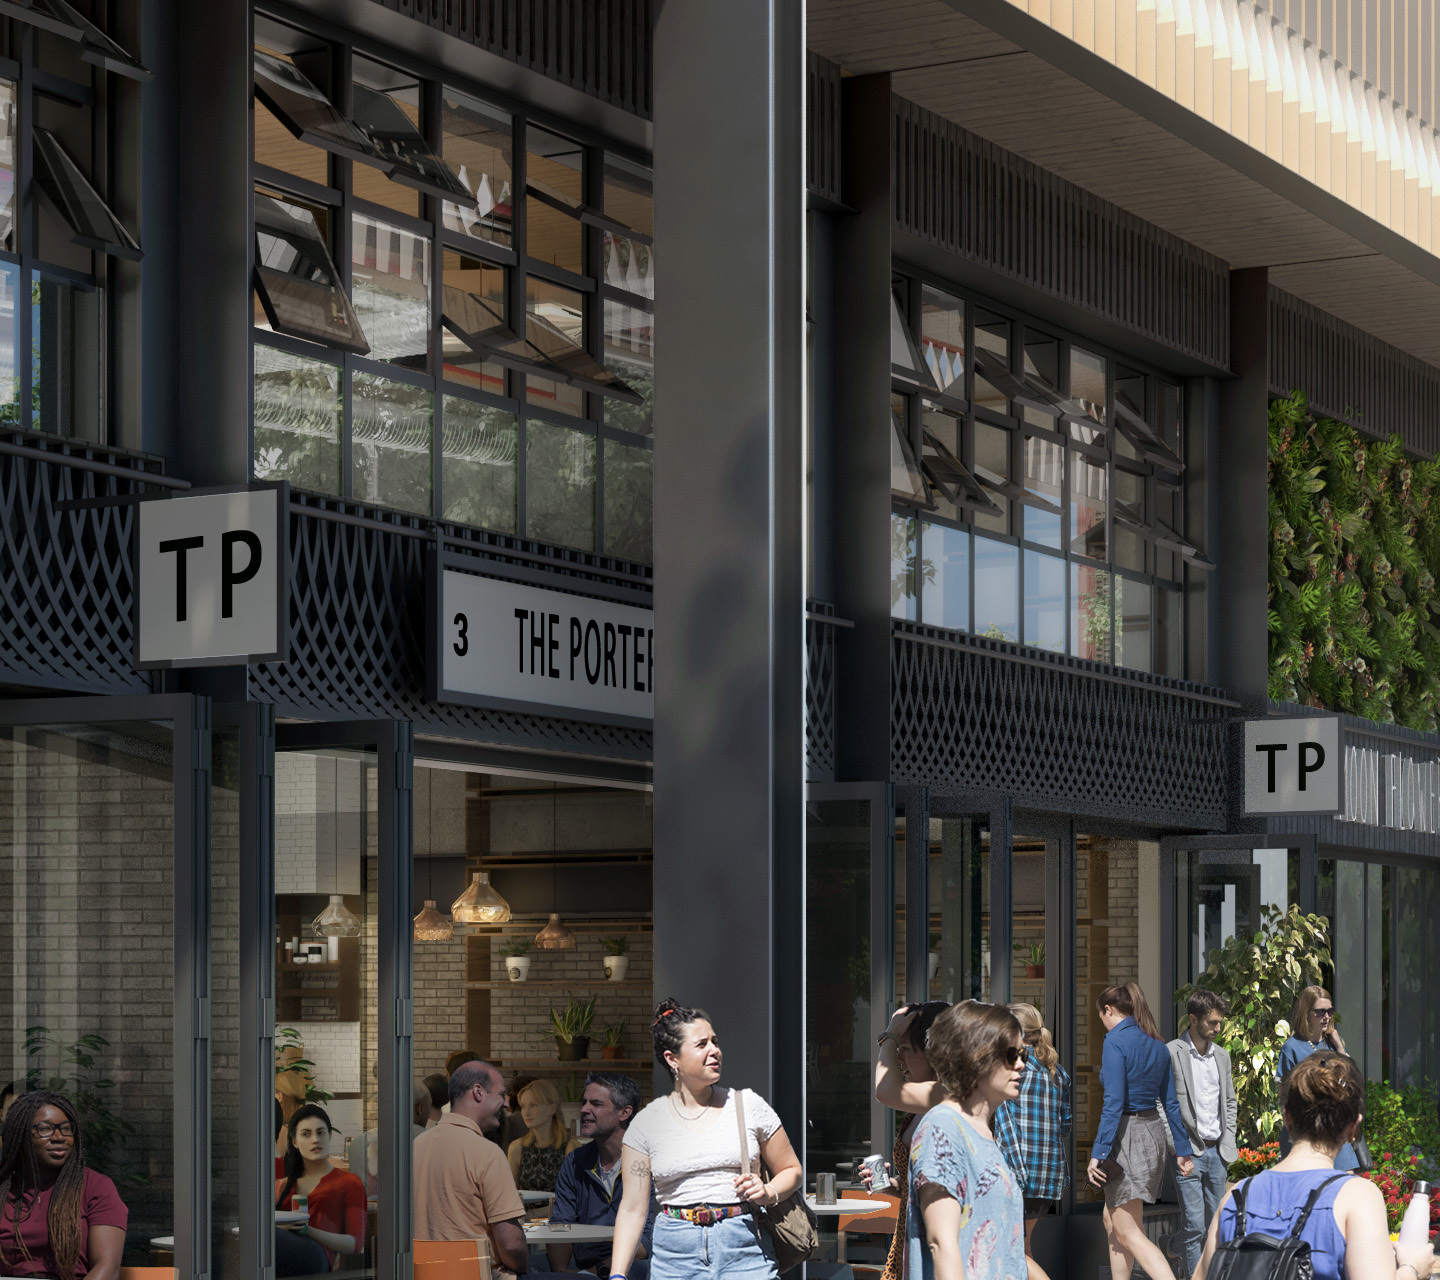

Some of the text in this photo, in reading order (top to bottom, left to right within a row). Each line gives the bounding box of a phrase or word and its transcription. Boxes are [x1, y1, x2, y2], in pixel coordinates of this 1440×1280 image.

[159, 529, 262, 622] TP
[453, 613, 469, 657] 3
[514, 608, 560, 679] THE
[1256, 741, 1326, 793] TP
